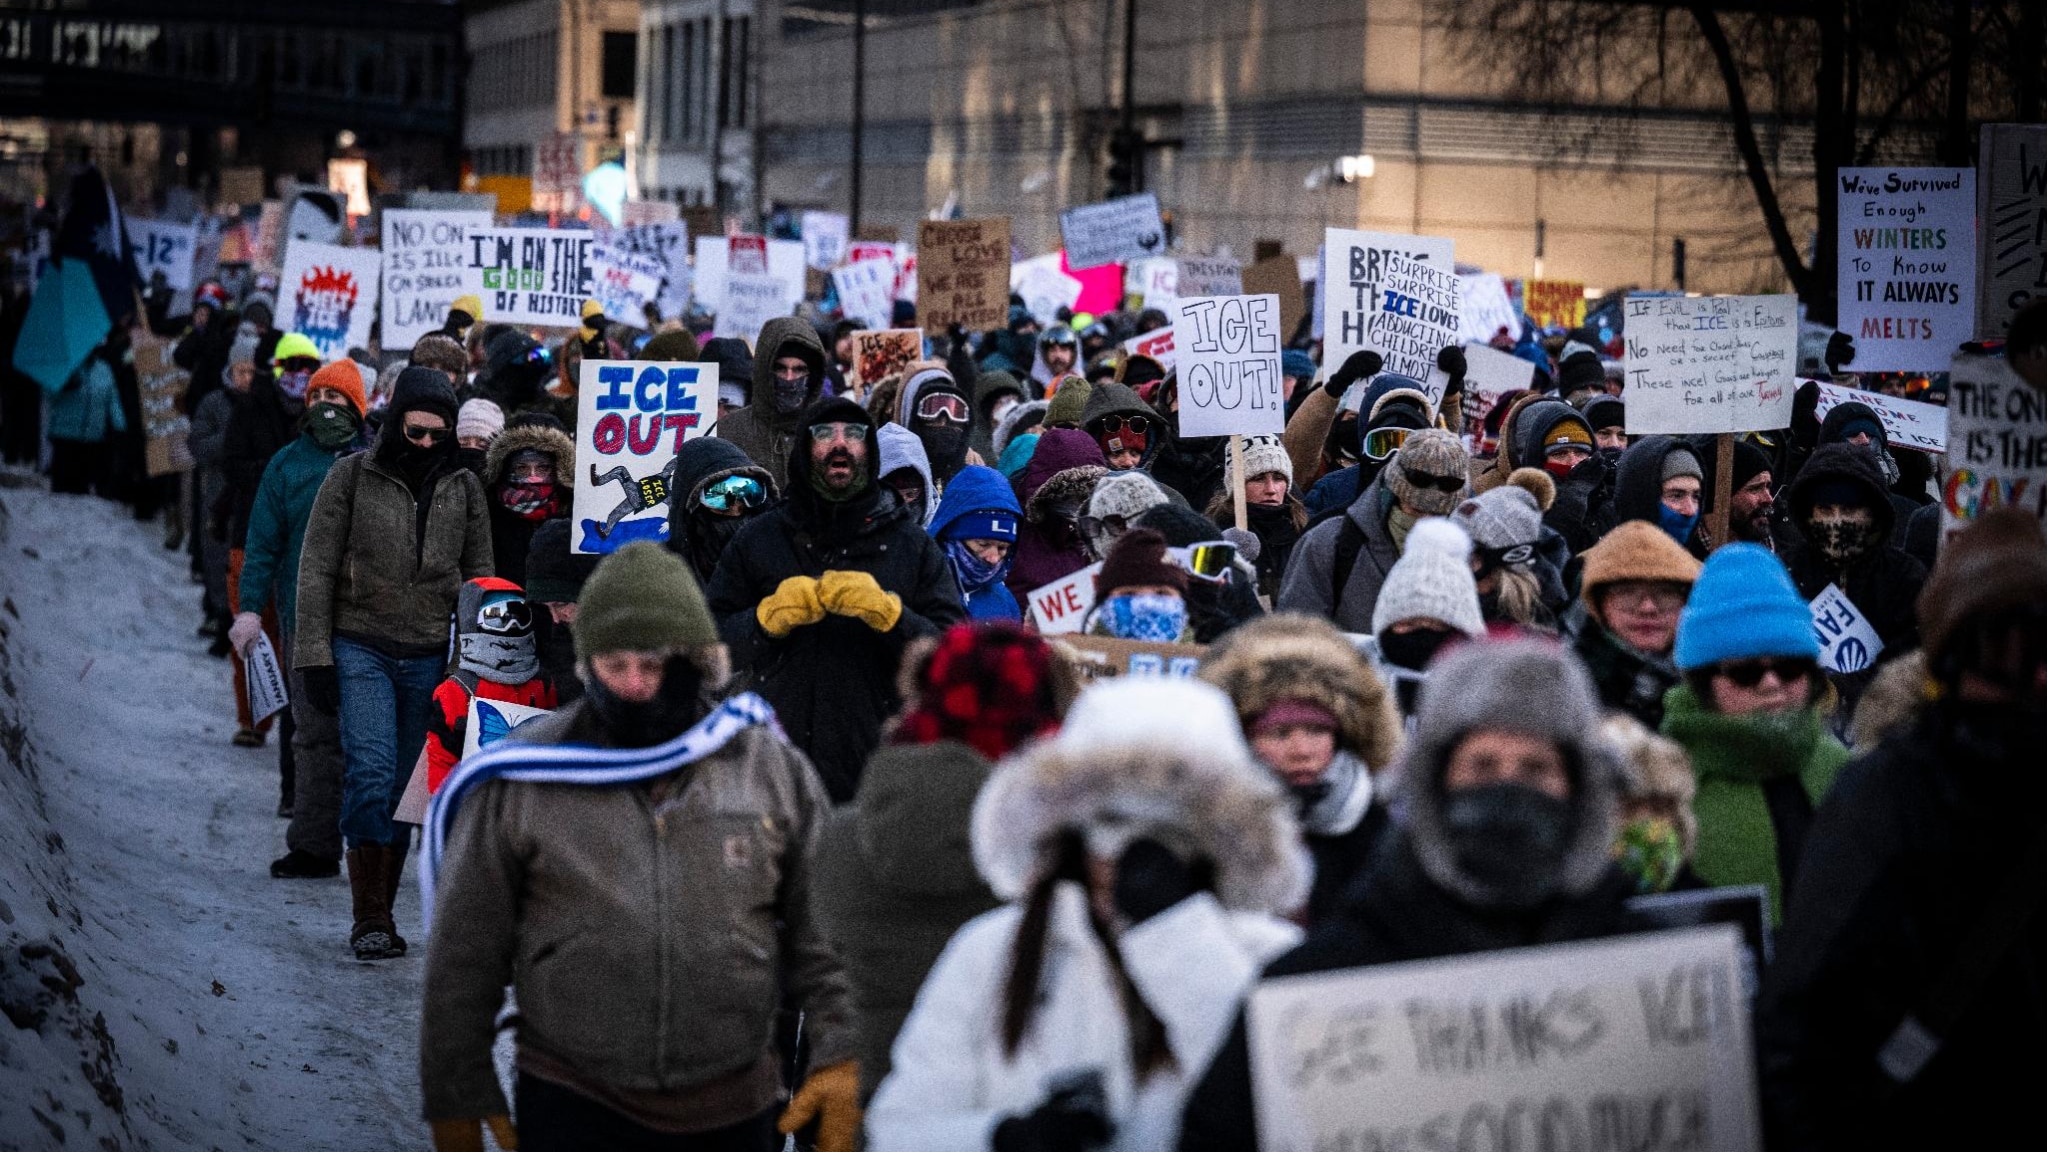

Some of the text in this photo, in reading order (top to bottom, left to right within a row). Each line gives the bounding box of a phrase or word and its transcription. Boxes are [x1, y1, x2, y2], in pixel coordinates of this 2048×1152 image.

[1841, 173, 1961, 196] We've Survived
[1864, 200, 1926, 223] Enough
[392, 220, 466, 247] NO ON
[1854, 228, 1947, 250] WINTERS
[391, 251, 416, 271] IS
[468, 235, 514, 270] I'M
[522, 236, 546, 270] ON
[551, 237, 594, 271] THE
[1852, 255, 1947, 276] To Know
[388, 274, 412, 294] ON
[483, 267, 545, 291] GOOD
[551, 268, 593, 296] SIDE
[1390, 256, 1460, 295] SURPRISE
[496, 291, 518, 312] OF
[1387, 275, 1460, 310] SURPRISE
[1857, 280, 1959, 305] IT ALWAYS
[1383, 290, 1421, 318] ICE
[1420, 302, 1459, 332] LOVES
[1693, 316, 1729, 331] ICE
[1182, 298, 1277, 354] ICE
[1375, 312, 1455, 347] ABDUCTING
[1861, 317, 1933, 340] MELTS
[860, 333, 885, 352] ICE
[1371, 329, 1438, 363] CHILDRE
[1628, 337, 1649, 360] No
[1382, 352, 1436, 382] ALMOST
[1629, 369, 1673, 389] These
[596, 366, 700, 413] ICE
[1188, 359, 1278, 411] OUT!
[1709, 390, 1723, 404] all
[1849, 392, 1887, 408] ARE
[1954, 382, 2046, 423] THE ON
[593, 412, 702, 456] OUT
[1967, 428, 2046, 469] IS THE
[1945, 468, 2030, 520] GAY
[1037, 583, 1084, 622] WE
[262, 652, 284, 704] JANUARY
